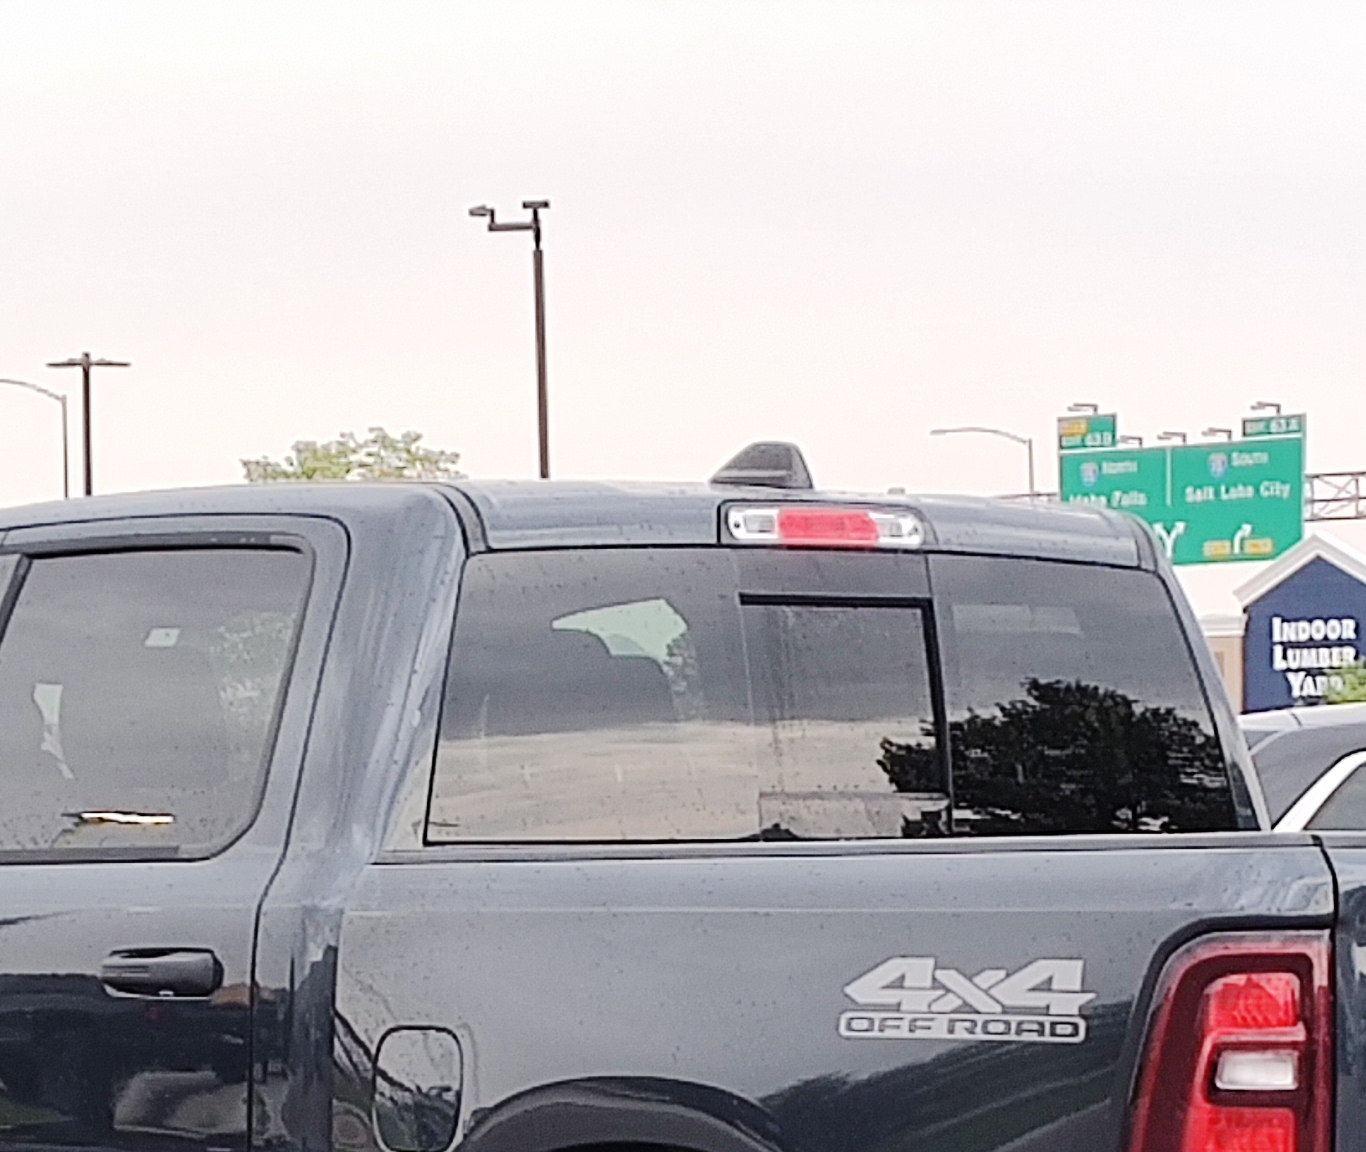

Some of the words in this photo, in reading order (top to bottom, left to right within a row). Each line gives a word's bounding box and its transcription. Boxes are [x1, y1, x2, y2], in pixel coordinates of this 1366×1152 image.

[1111, 490, 1148, 507] Falls
[1185, 484, 1215, 503] Salt
[1220, 483, 1254, 500] Lake
[1259, 480, 1291, 500] City
[1272, 616, 1357, 643] INDOOR
[1273, 643, 1356, 671] LUMBER
[844, 1015, 935, 1035] OFF
[945, 1016, 1083, 1038] ROAD
